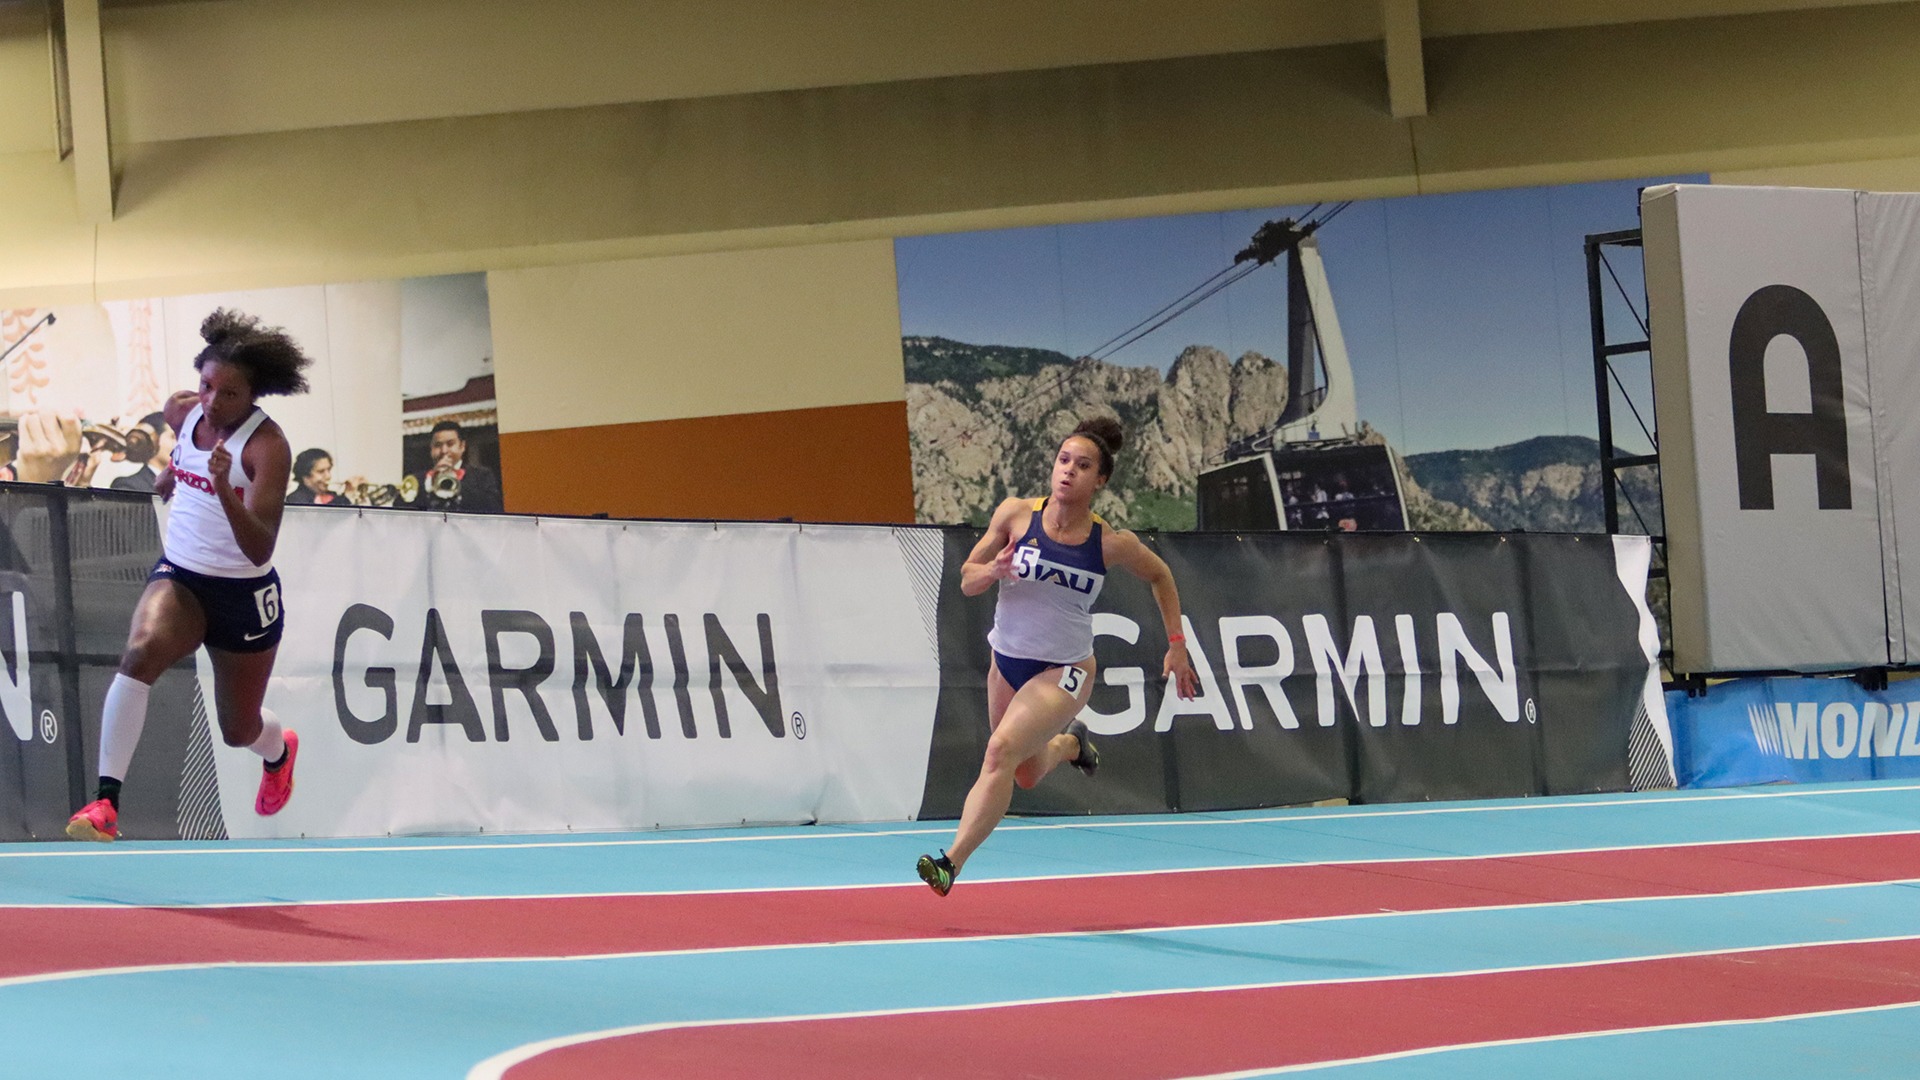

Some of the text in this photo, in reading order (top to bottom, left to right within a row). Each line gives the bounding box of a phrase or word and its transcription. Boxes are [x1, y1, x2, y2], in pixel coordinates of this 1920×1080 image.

[1729, 284, 1852, 510] A
[1018, 549, 1034, 578] 5
[263, 588, 276, 621] 6
[1064, 667, 1083, 692] 5
